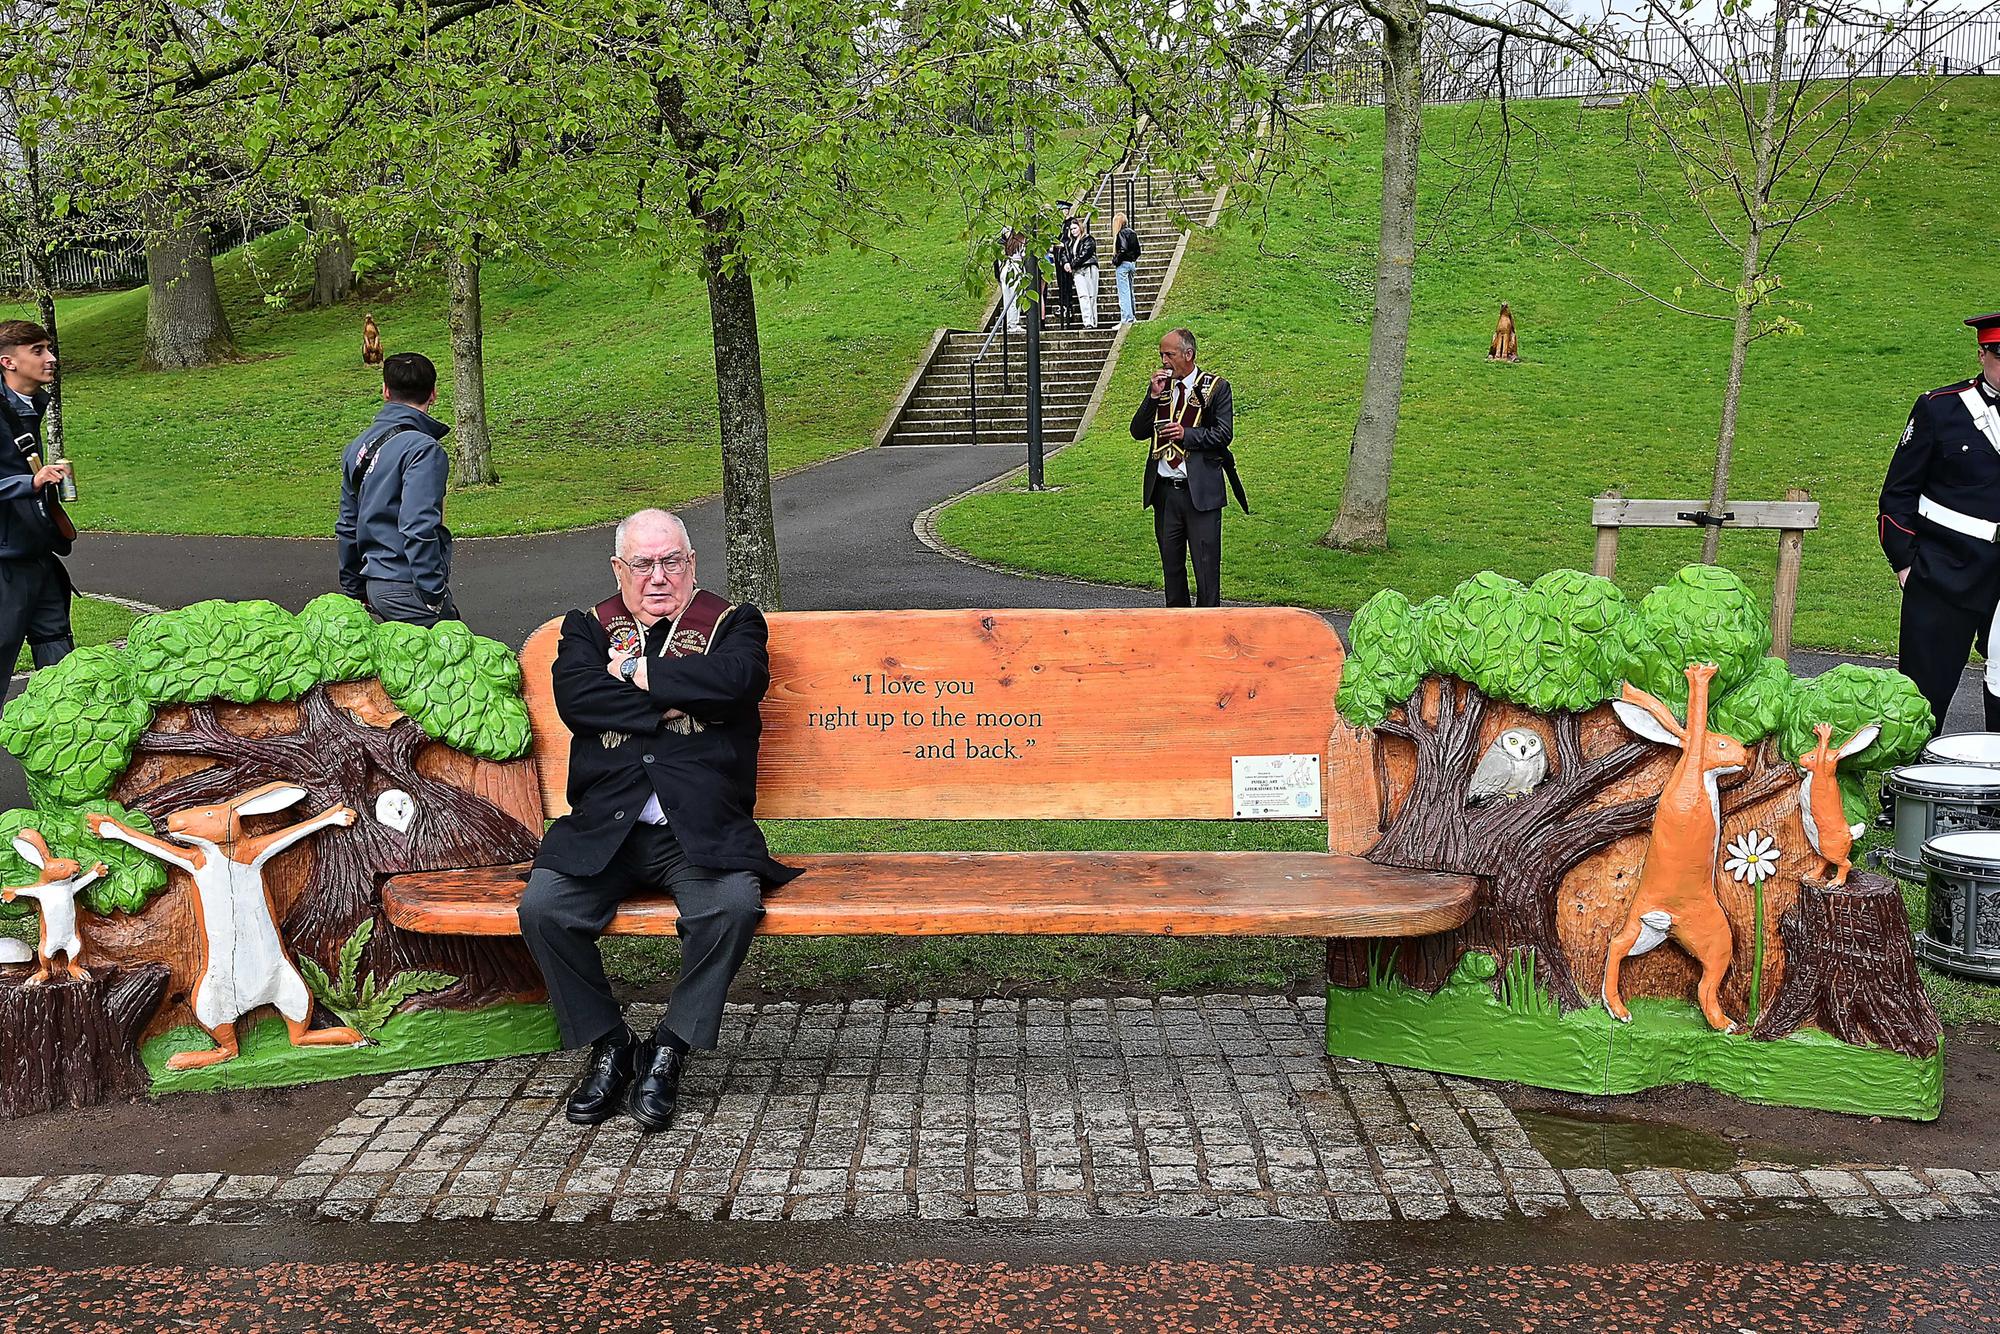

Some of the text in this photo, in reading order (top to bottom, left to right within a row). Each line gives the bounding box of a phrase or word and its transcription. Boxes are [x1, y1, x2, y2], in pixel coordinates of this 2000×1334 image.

[605, 620, 636, 633] PRESIDENT
[673, 629, 700, 640] APPRENTICE
[680, 638, 698, 646] DERRY
[881, 673, 927, 695] love
[934, 679, 975, 698] you
[807, 706, 1043, 731] right up to the moon
